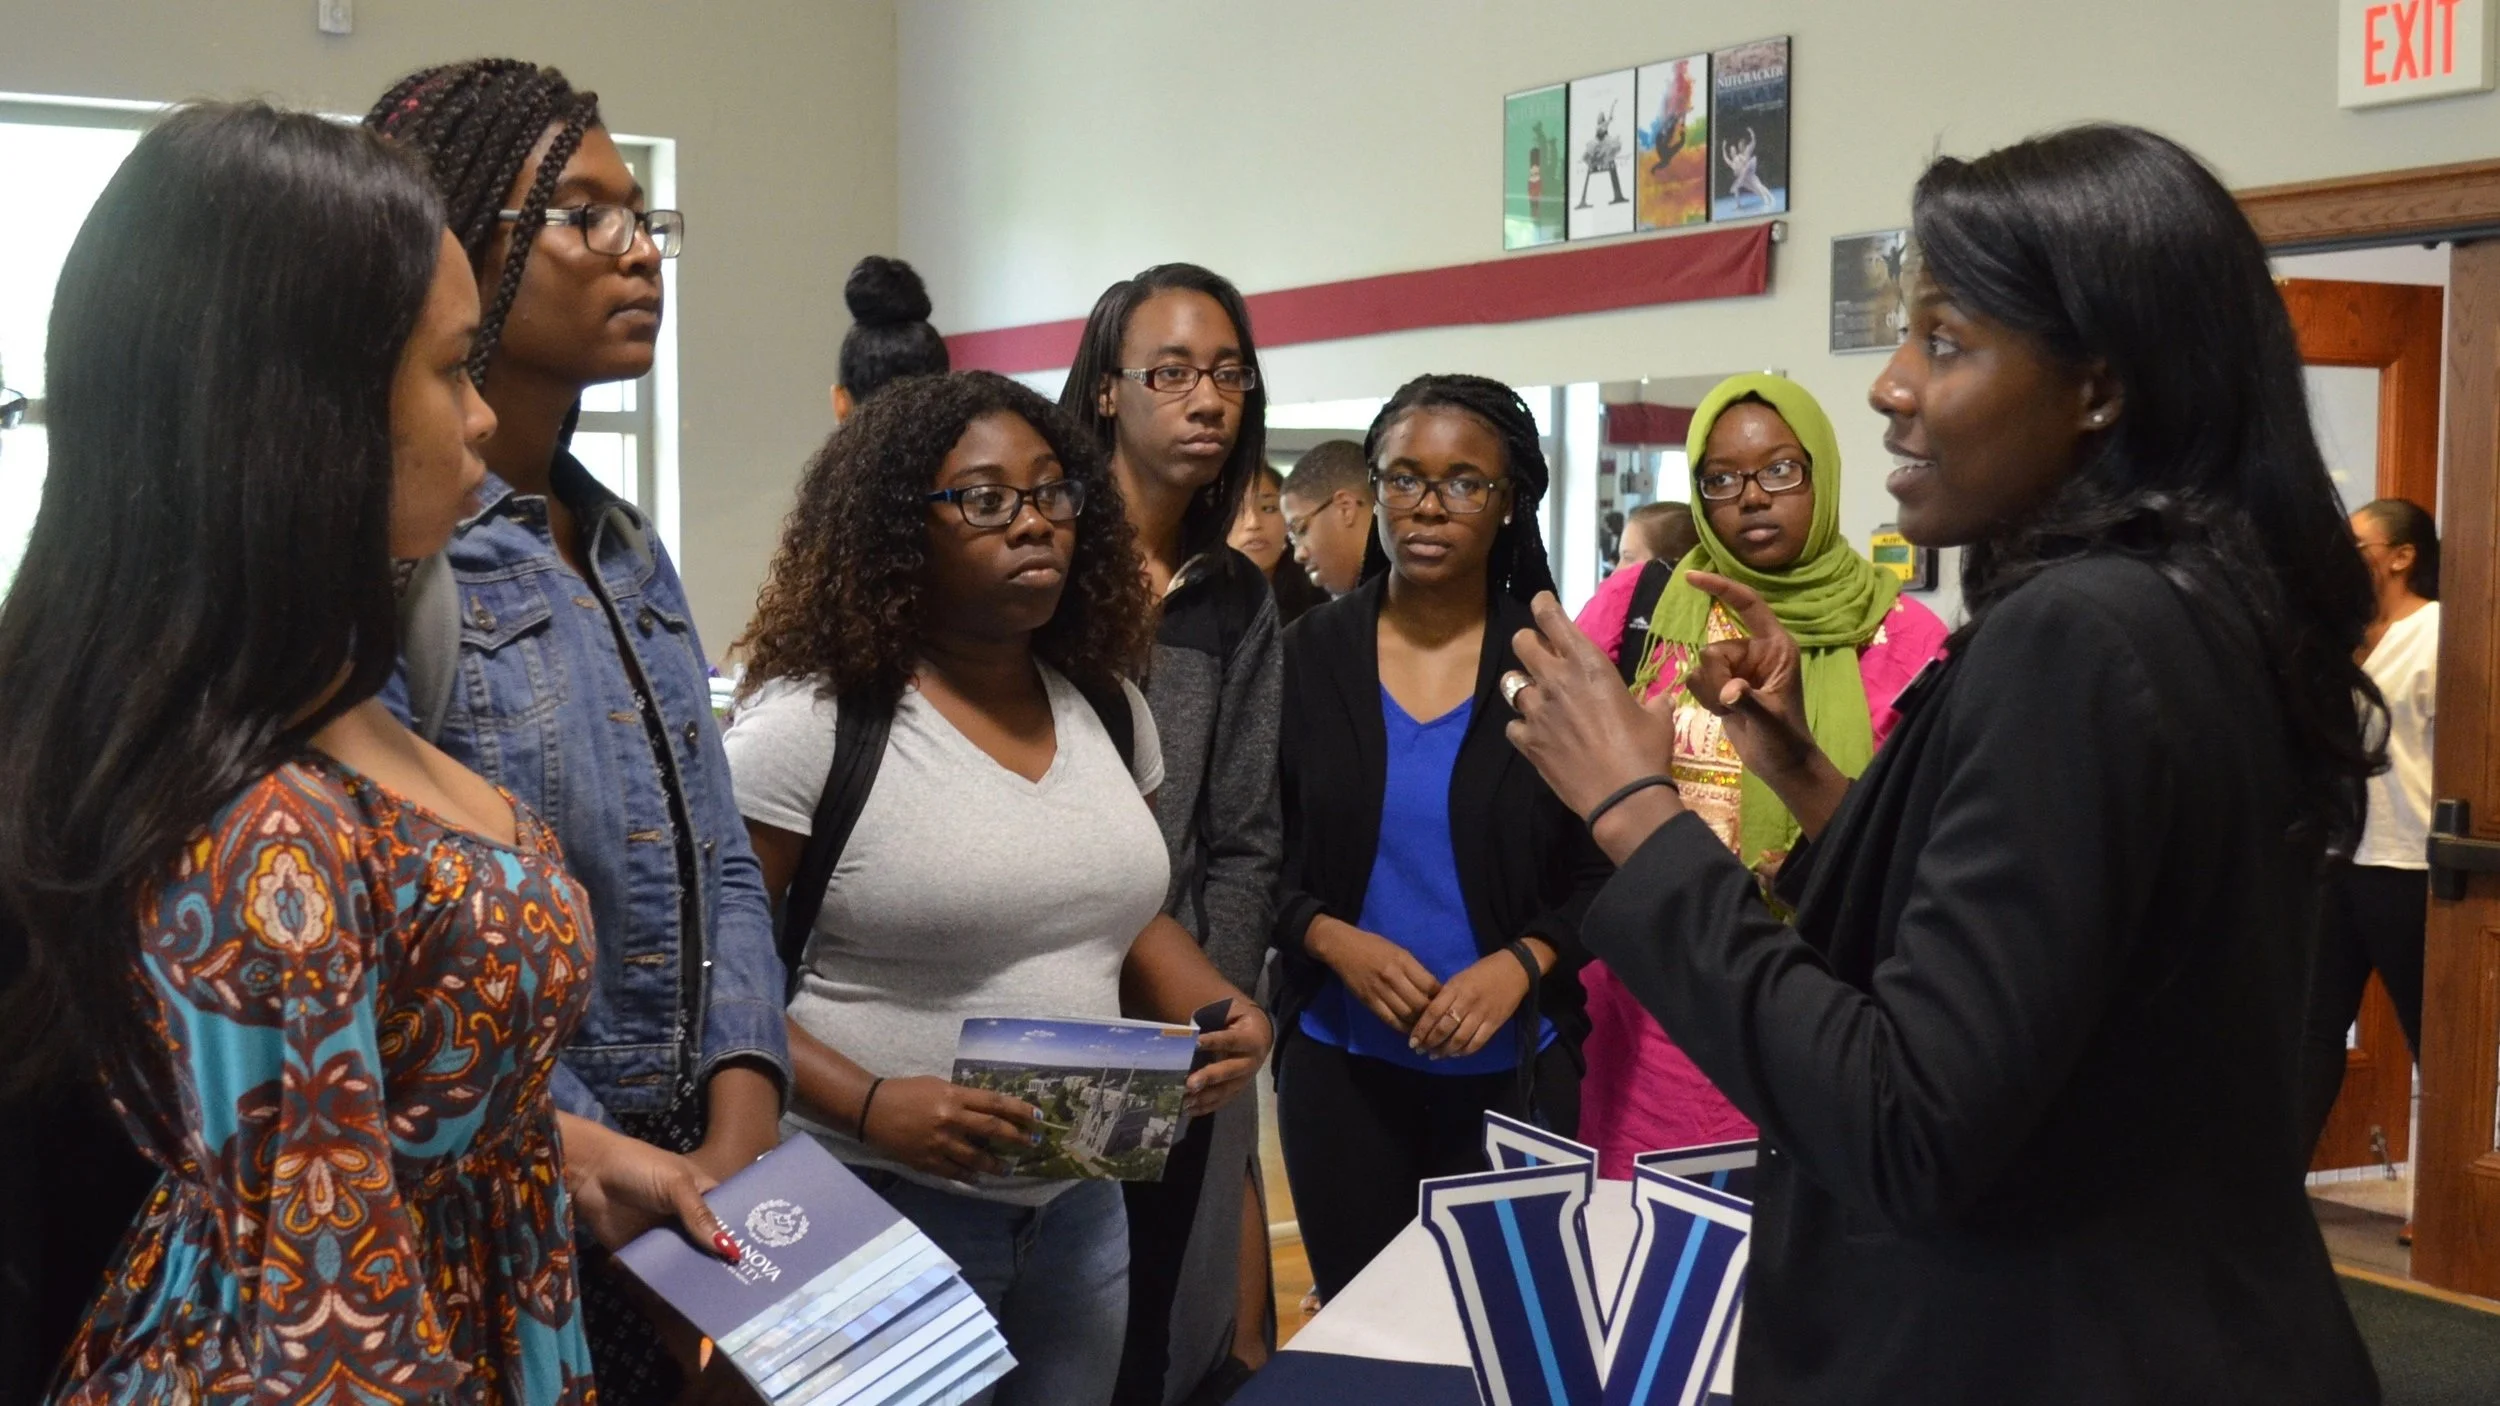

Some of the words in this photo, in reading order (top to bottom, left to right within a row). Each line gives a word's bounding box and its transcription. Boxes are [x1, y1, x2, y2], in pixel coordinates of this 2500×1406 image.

[1717, 66, 1784, 88] NUTCRACKER
[2364, 0, 2462, 86] EXIT
[716, 1215, 782, 1283] ANOVA
